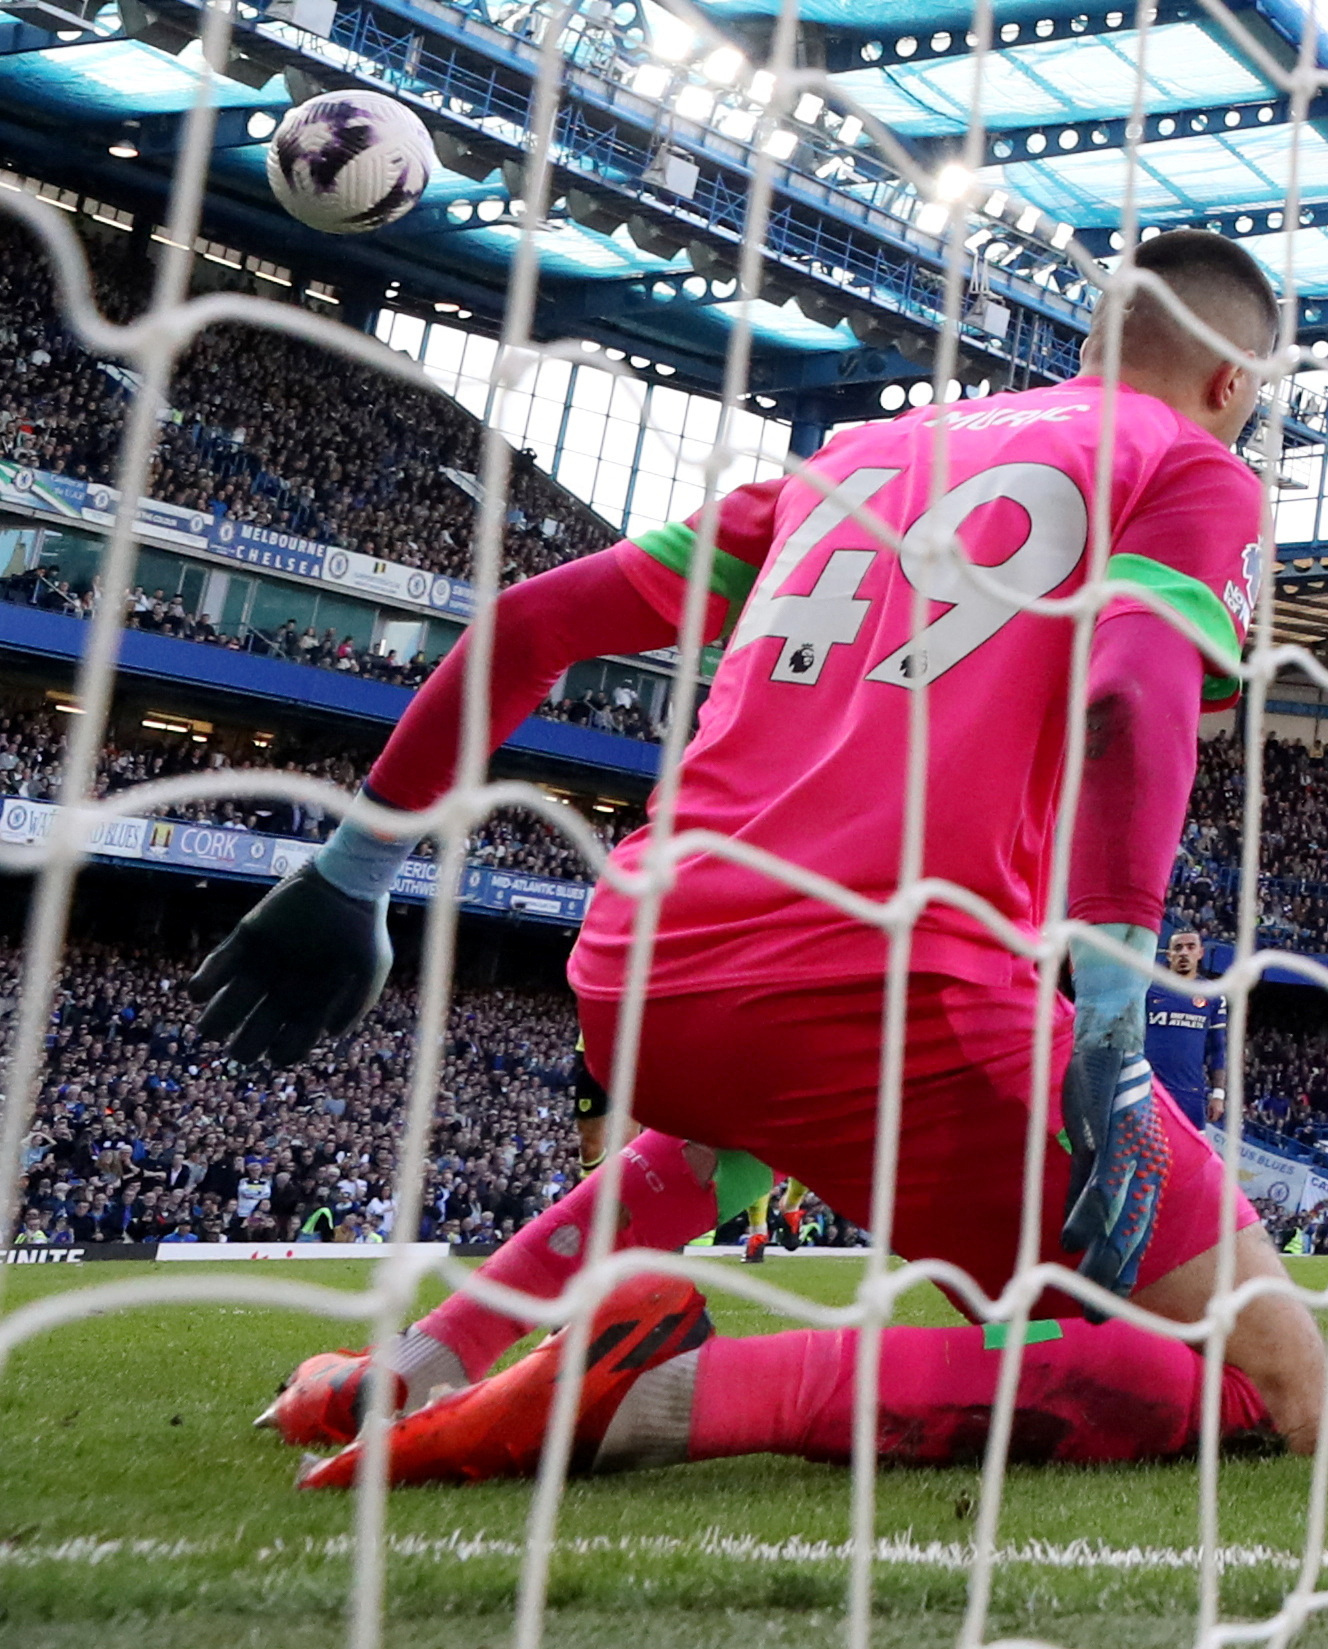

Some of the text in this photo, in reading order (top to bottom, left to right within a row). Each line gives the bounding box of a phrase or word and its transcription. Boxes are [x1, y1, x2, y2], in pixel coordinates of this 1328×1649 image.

[241, 524, 326, 558] MELBOURNE
[235, 545, 320, 577] CHELSEA
[730, 462, 1089, 689] 49
[180, 828, 239, 857] CORK
[1212, 1132, 1296, 1176] CYUS BLUES
